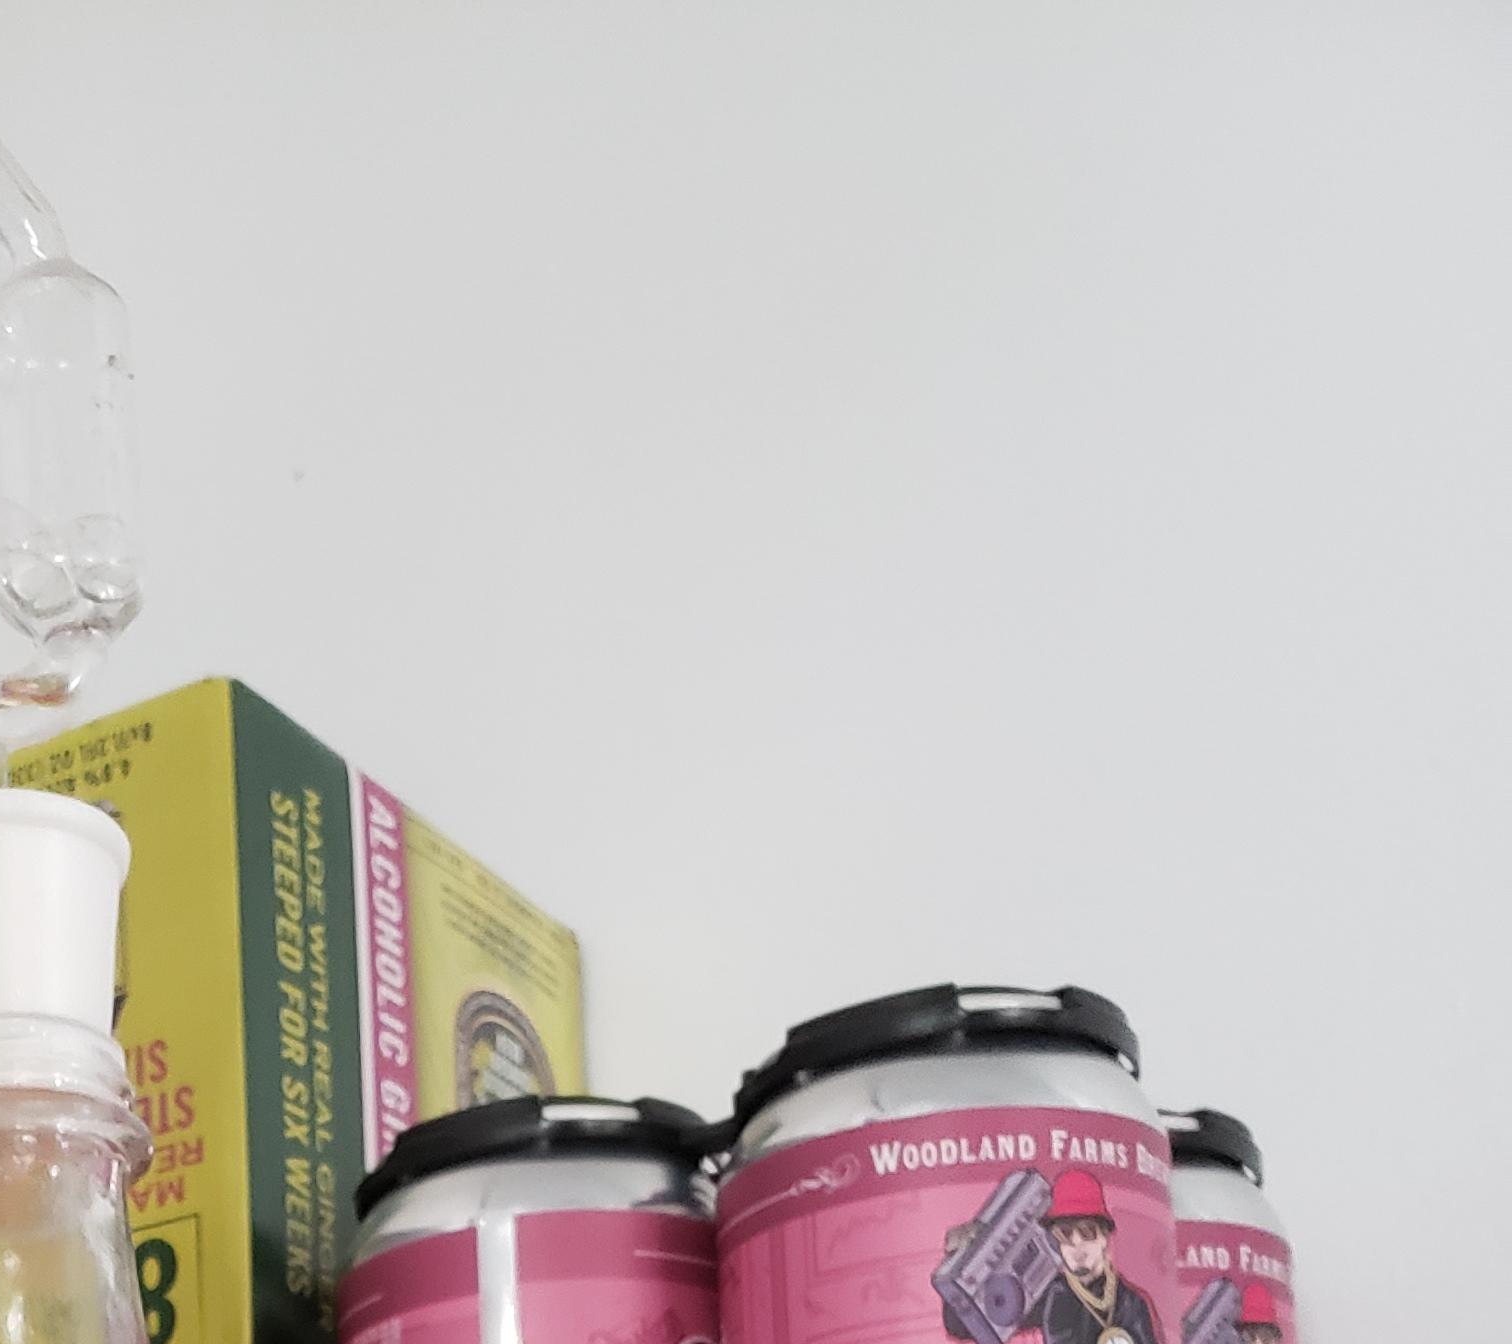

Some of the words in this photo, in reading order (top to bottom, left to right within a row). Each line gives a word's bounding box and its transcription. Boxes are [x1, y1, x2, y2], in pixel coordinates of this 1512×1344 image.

[269, 791, 306, 972] STEEPED
[300, 788, 326, 911] MADE
[308, 930, 330, 1027] WITH
[366, 795, 409, 1066] ALCOHOLIC
[278, 981, 309, 1066] FOR
[281, 1074, 311, 1143] SIX
[312, 1037, 334, 1151] REAL
[869, 1132, 1037, 1175] WOODLAND
[1049, 1128, 1128, 1169] FARMS
[284, 1155, 316, 1298] WEEKS
